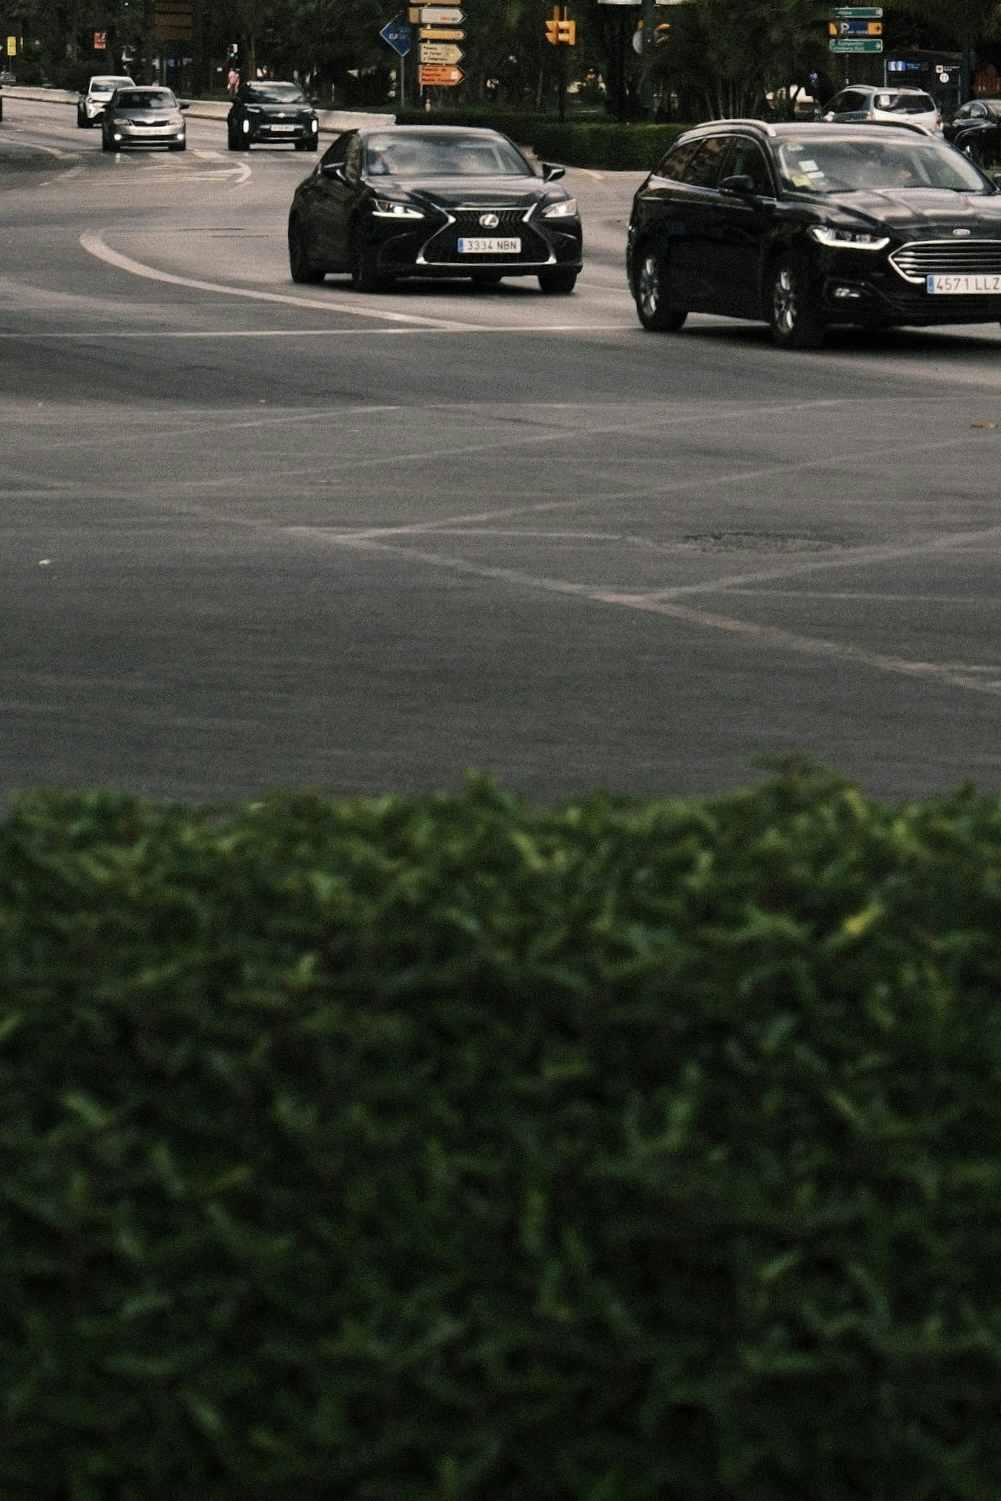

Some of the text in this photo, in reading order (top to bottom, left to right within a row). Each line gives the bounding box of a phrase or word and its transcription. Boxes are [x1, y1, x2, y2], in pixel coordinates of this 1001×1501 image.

[468, 240, 516, 251] 3334 NBN
[936, 277, 1000, 291] 4571 LLZ
